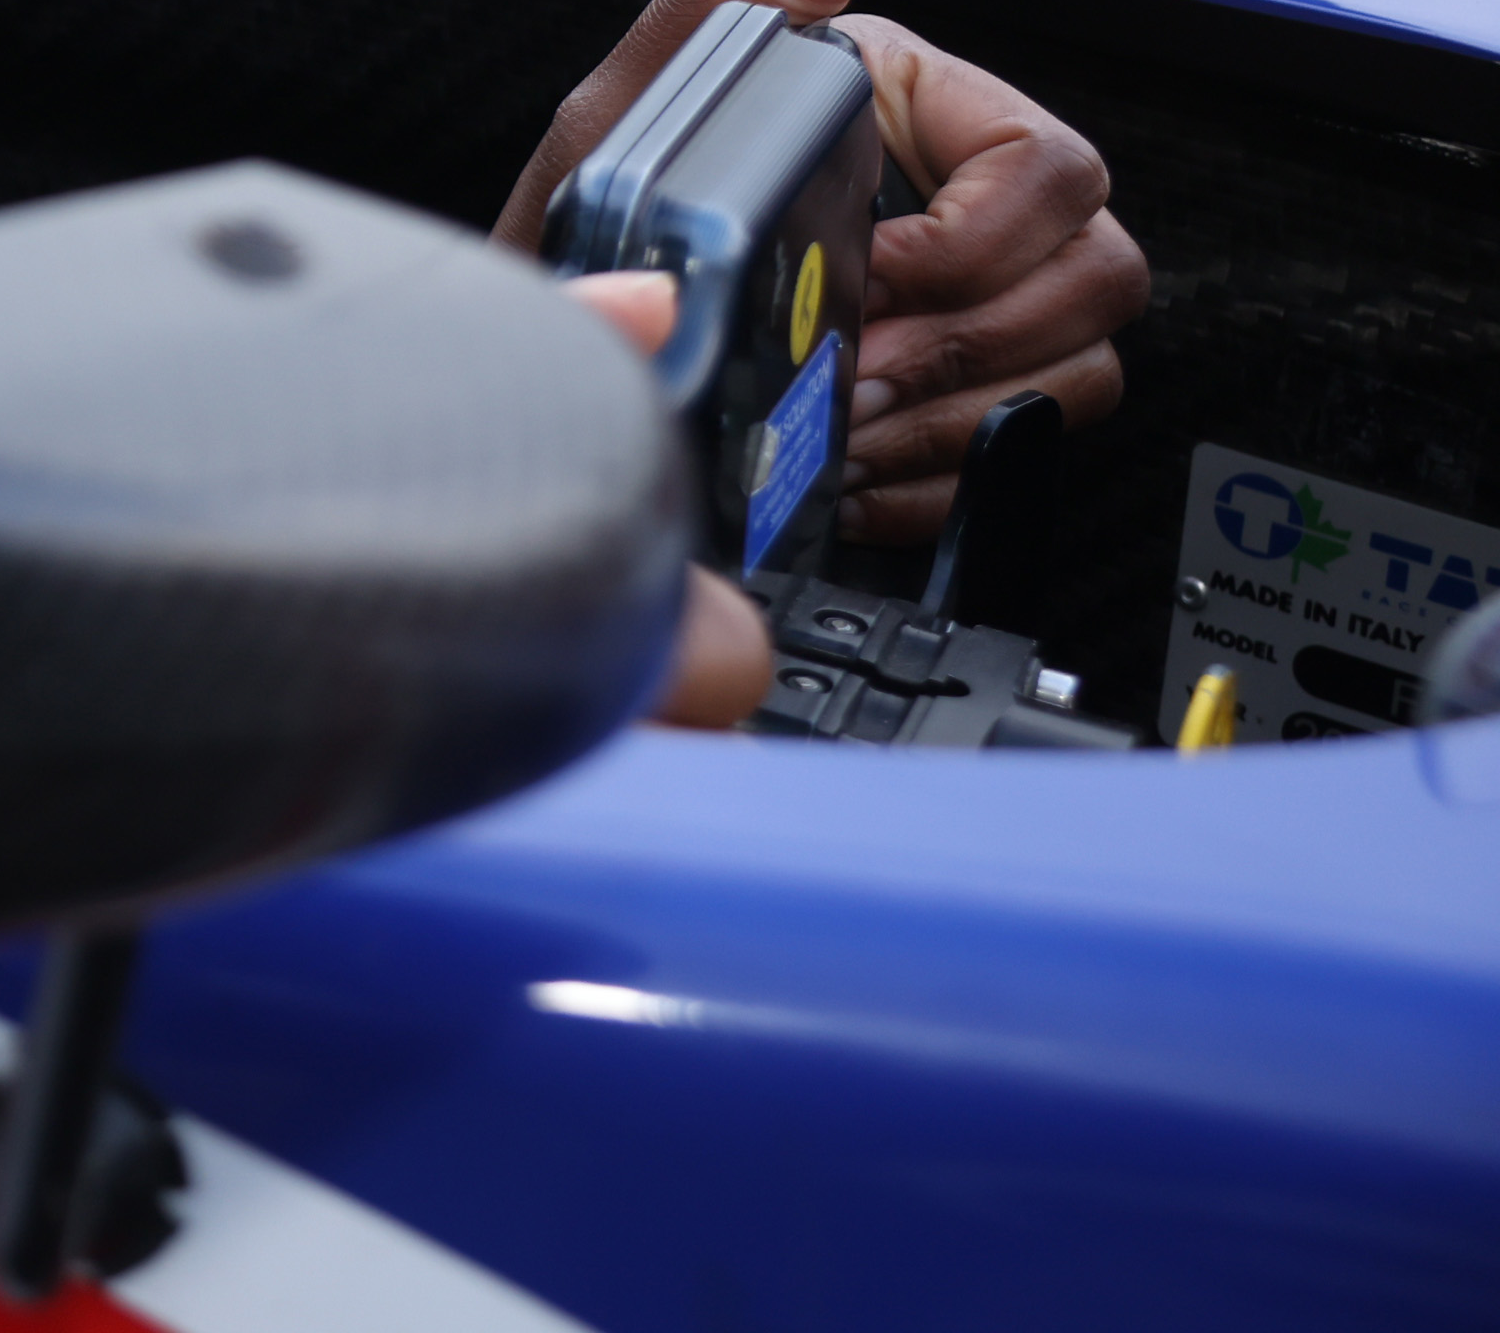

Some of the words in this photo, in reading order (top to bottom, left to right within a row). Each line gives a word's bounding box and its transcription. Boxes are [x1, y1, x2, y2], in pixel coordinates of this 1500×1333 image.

[1192, 621, 1278, 664] MODEL
[1210, 569, 1293, 614] MADE
[1303, 599, 1337, 629] IN
[1347, 612, 1425, 653] ITALY
